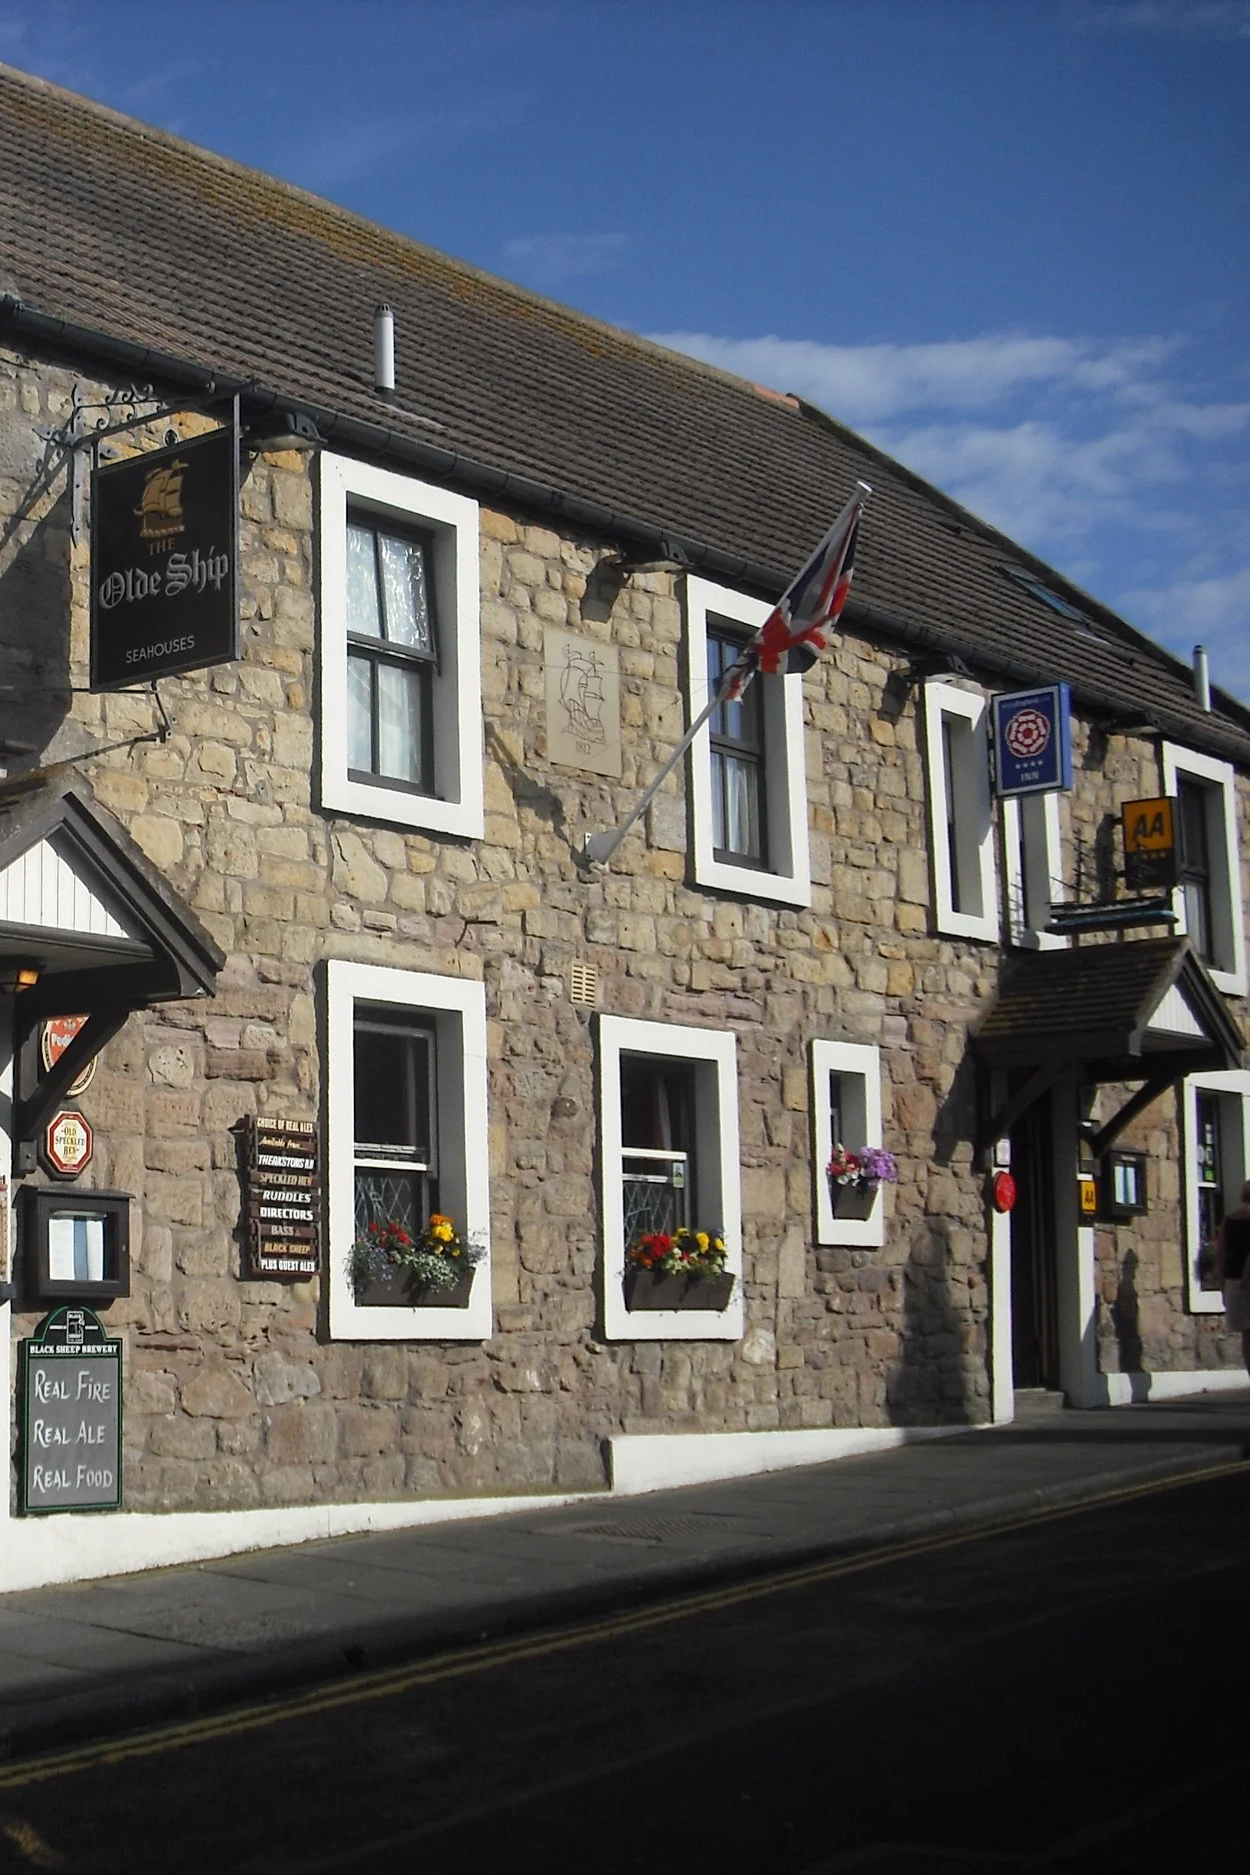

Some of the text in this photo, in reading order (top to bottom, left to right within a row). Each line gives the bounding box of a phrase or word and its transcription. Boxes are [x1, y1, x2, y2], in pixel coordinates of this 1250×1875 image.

[148, 538, 175, 556] THE
[99, 544, 229, 610] Olde Ship
[125, 635, 195, 664] SEAHOUSES
[1020, 770, 1040, 782] INN
[1133, 810, 1165, 839] AA
[257, 1117, 277, 1130] CHOICE
[278, 1119, 285, 1130] OF
[286, 1120, 299, 1132] REAL
[258, 1154, 305, 1169] THEAKSTONS
[260, 1172, 297, 1185] SPECKLED
[262, 1190, 311, 1204] RUDDLES
[260, 1206, 314, 1221] DIRECTORS
[271, 1225, 294, 1236] BASS
[264, 1242, 311, 1255] BLACK SHEEP
[261, 1259, 315, 1273] PLUS GUEST ALES
[30, 1345, 118, 1354] BLACK SHEEP BREWERY
